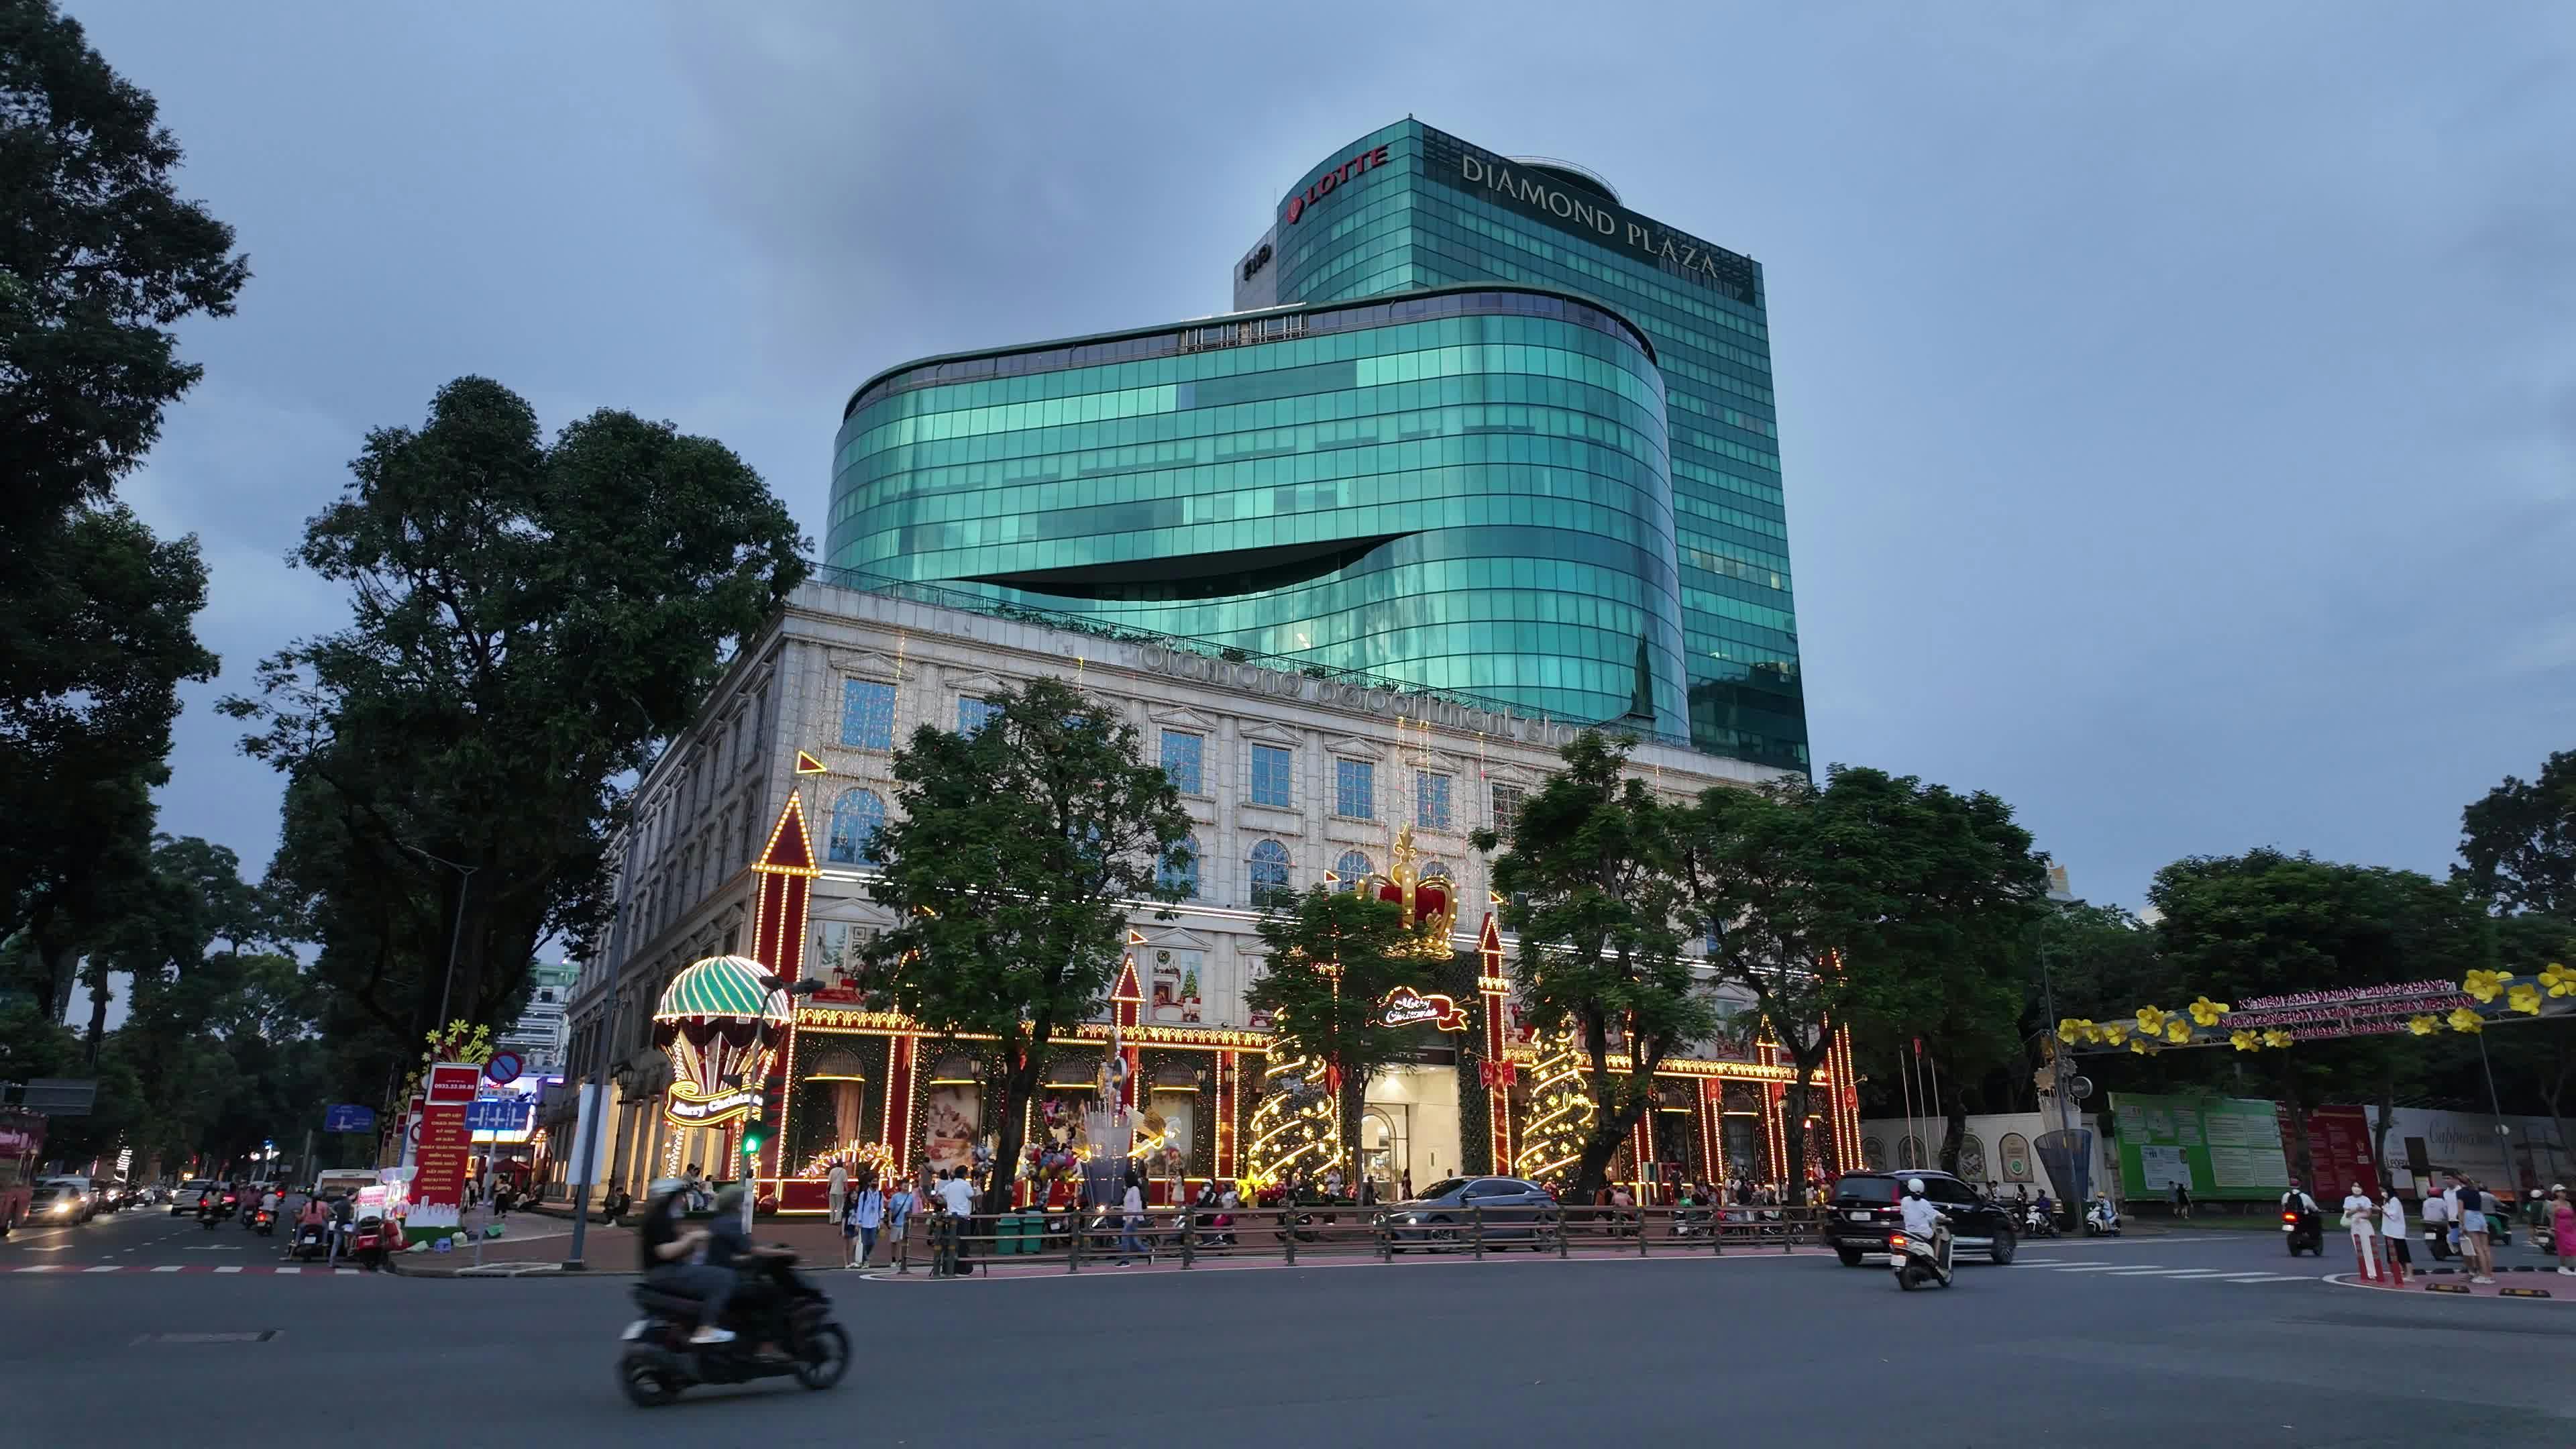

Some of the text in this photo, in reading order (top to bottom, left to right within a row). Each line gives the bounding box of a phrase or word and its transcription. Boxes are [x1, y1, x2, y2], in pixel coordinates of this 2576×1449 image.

[1305, 145, 1389, 205] LOTTE
[1462, 153, 1718, 279] DIAMOND PLAZA
[1140, 635, 1303, 696] diamond
[1524, 714, 1586, 746] stor
[672, 1100, 707, 1118] Merry
